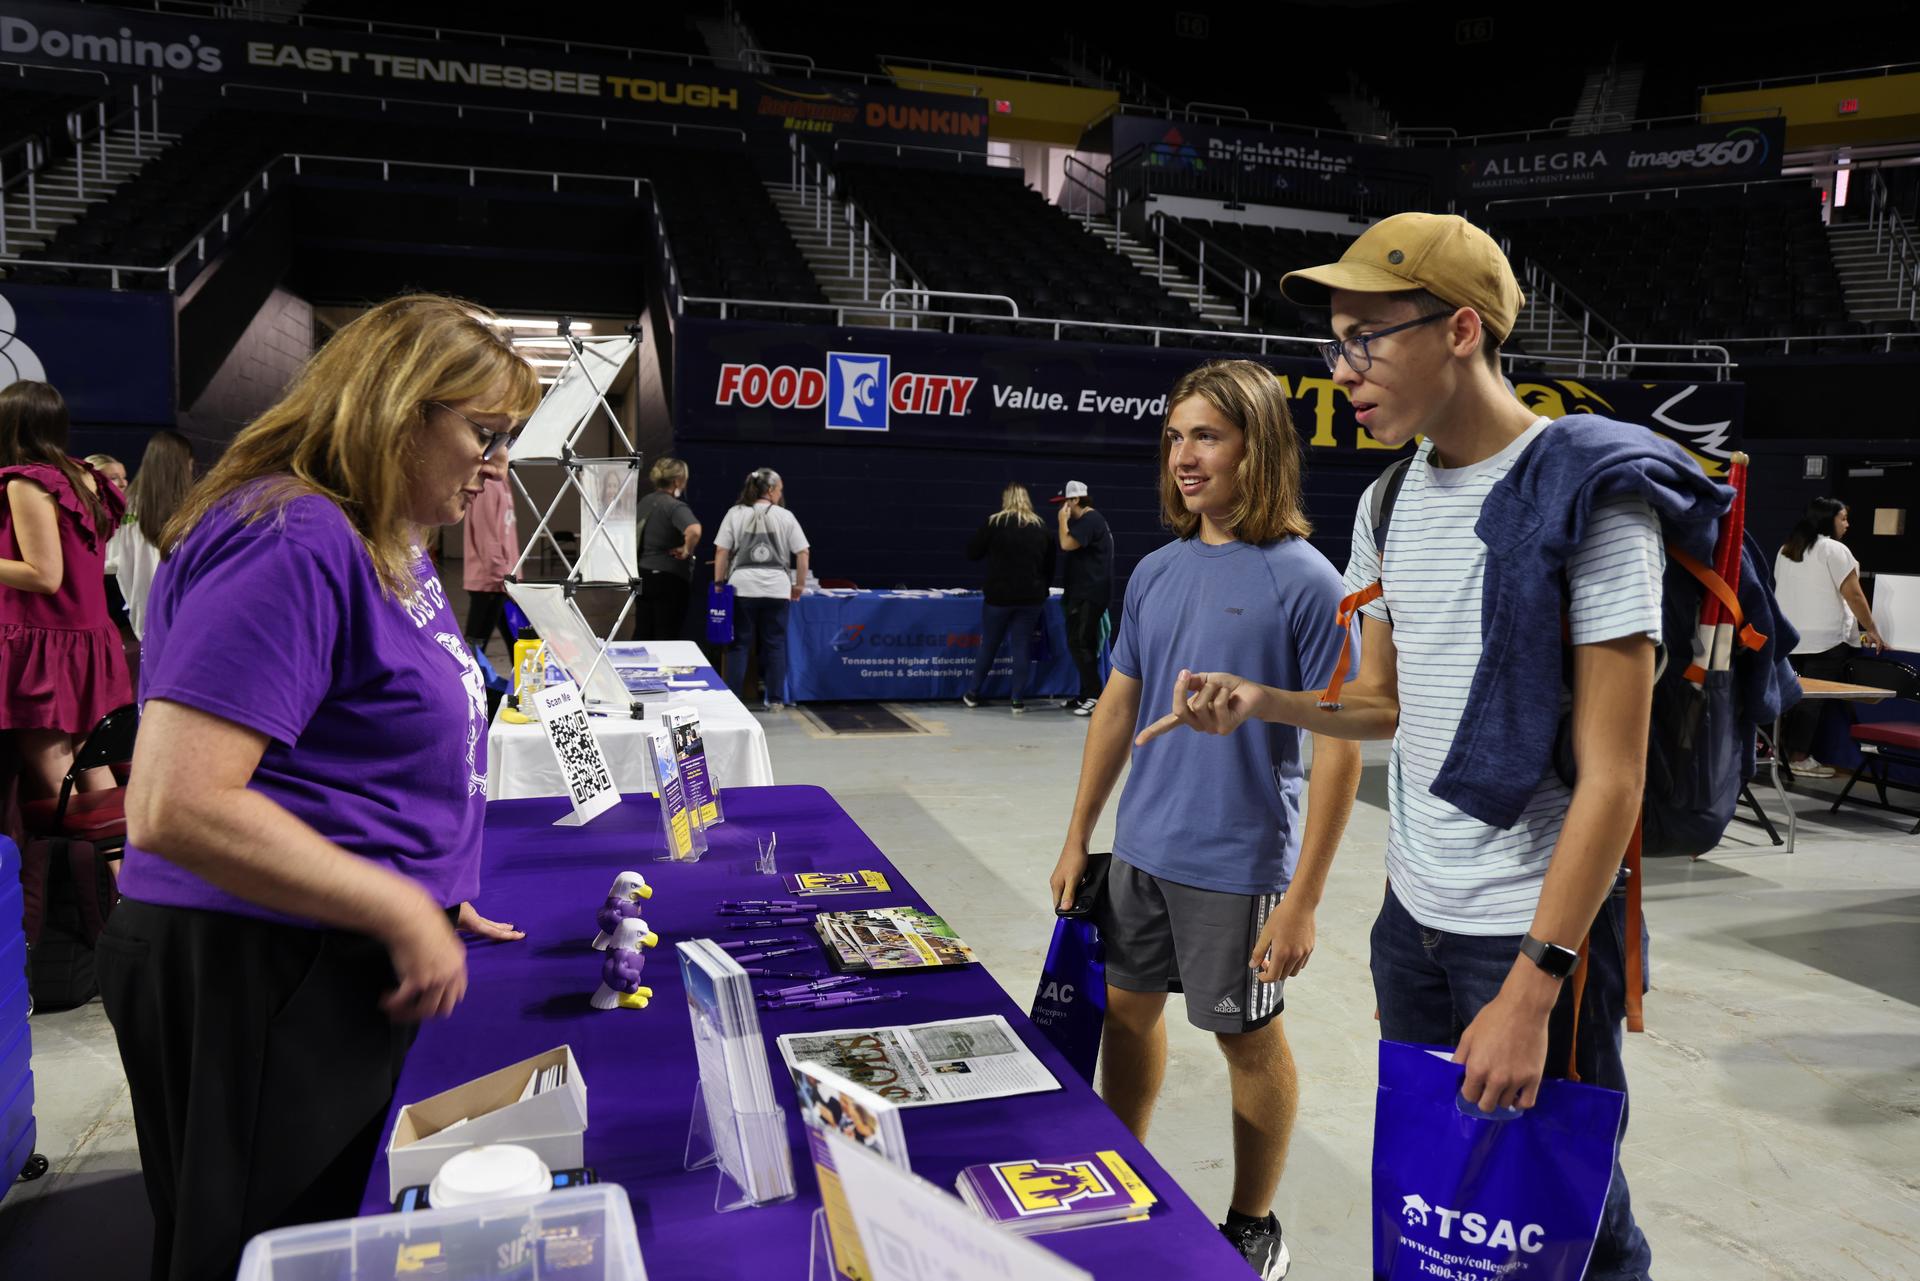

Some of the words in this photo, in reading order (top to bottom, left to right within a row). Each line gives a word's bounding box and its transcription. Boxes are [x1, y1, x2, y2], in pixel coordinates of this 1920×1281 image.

[0, 16, 223, 73] Domino's
[247, 42, 359, 74] EAST
[365, 52, 601, 96] TENNESSEE
[605, 75, 739, 110] TOUGH
[1482, 149, 1609, 177] ALLEGRA
[715, 363, 827, 409] FOOD
[890, 372, 978, 417] CITY
[992, 384, 1069, 411] Value.
[841, 656, 895, 665] Tennessee
[897, 656, 930, 667] Higher
[860, 669, 894, 678] Grants
[896, 669, 904, 678] &
[906, 668, 963, 679] Scholarship
[545, 695, 562, 709] Scan
[561, 692, 572, 702] Me
[1214, 1005, 1241, 1013] adidas
[1434, 1205, 1546, 1254] TSAC
